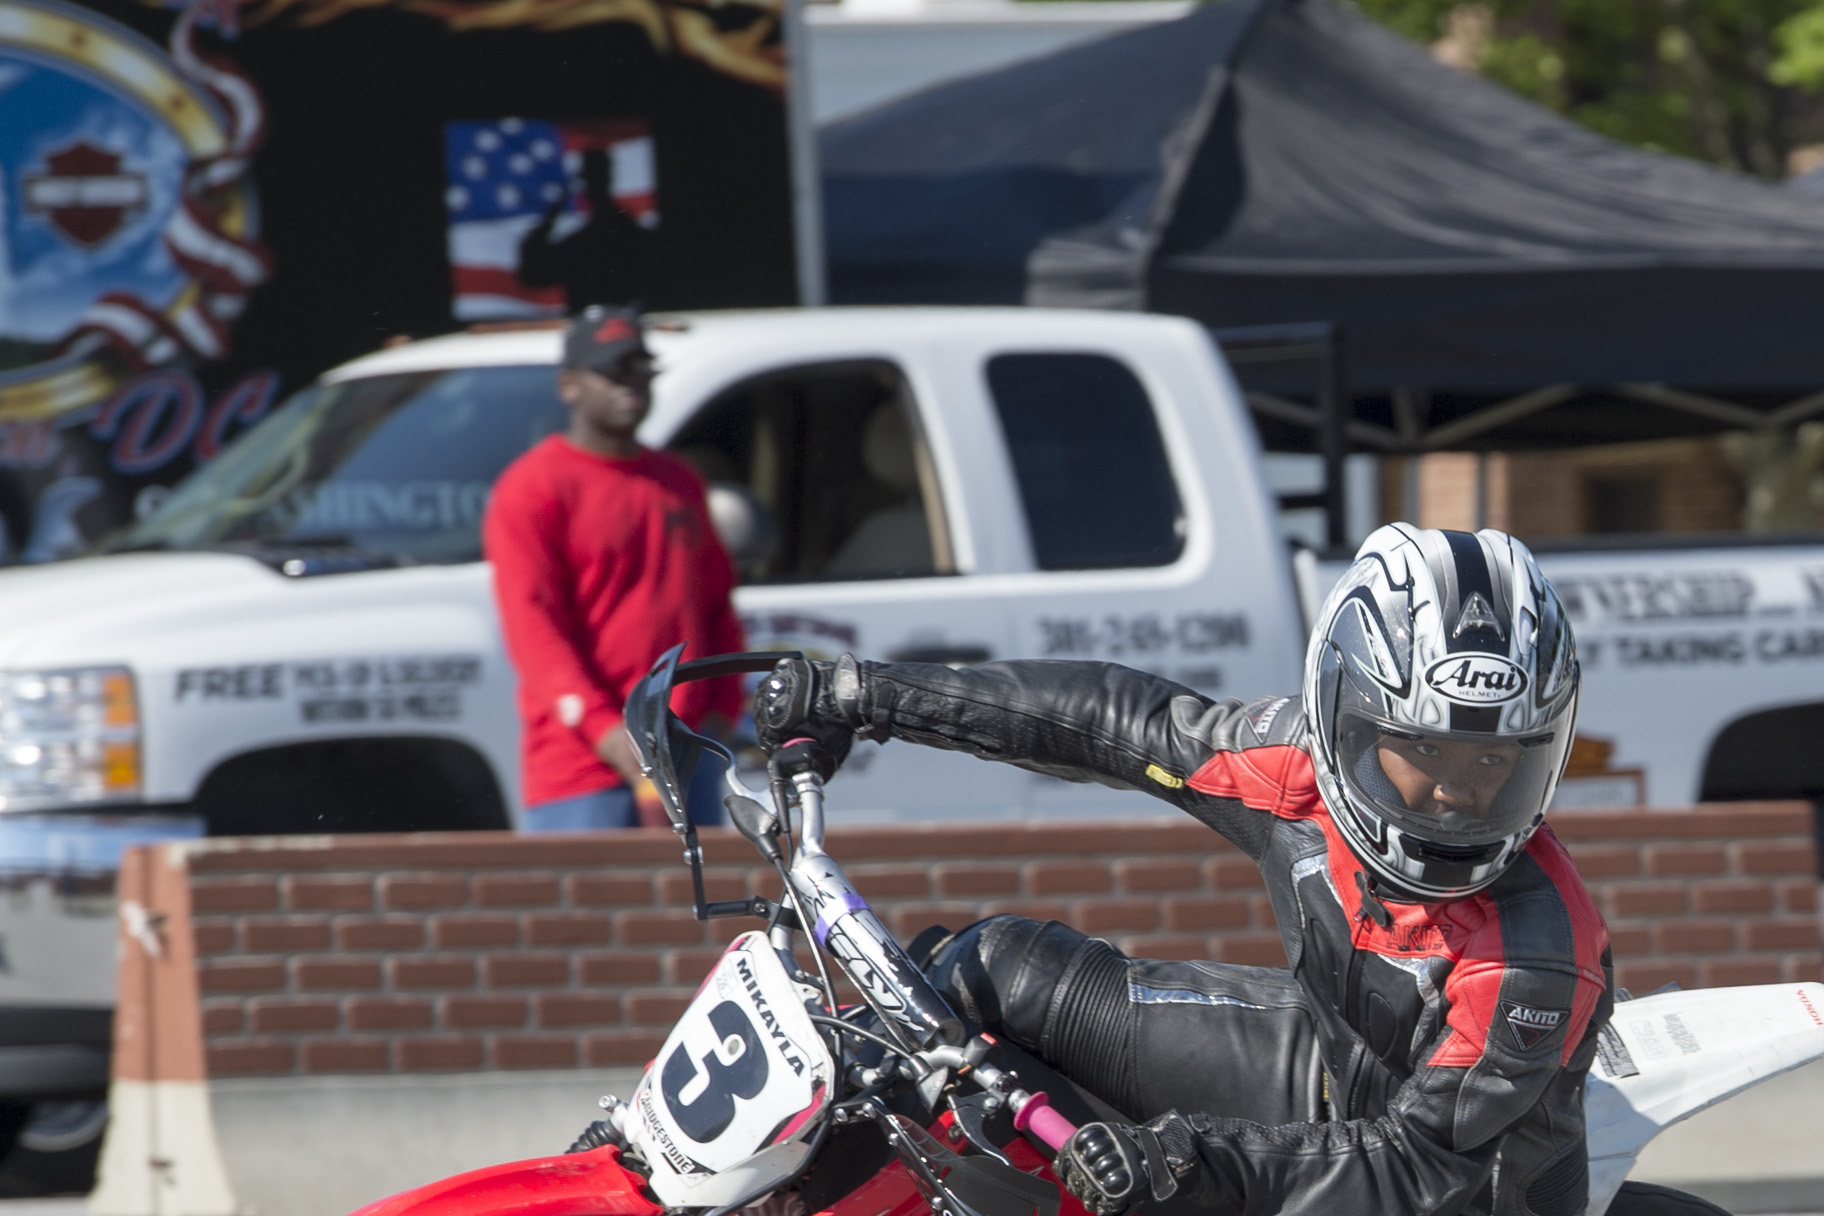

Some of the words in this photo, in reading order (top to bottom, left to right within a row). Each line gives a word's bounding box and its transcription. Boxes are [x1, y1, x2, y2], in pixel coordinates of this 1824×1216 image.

[174, 661, 284, 706] FREE
[1432, 660, 1519, 691] Arai
[1459, 690, 1498, 698] HELMET
[736, 957, 805, 1077] MIKAYLA
[1508, 1007, 1560, 1025] AKITO
[661, 1000, 769, 1144] 3
